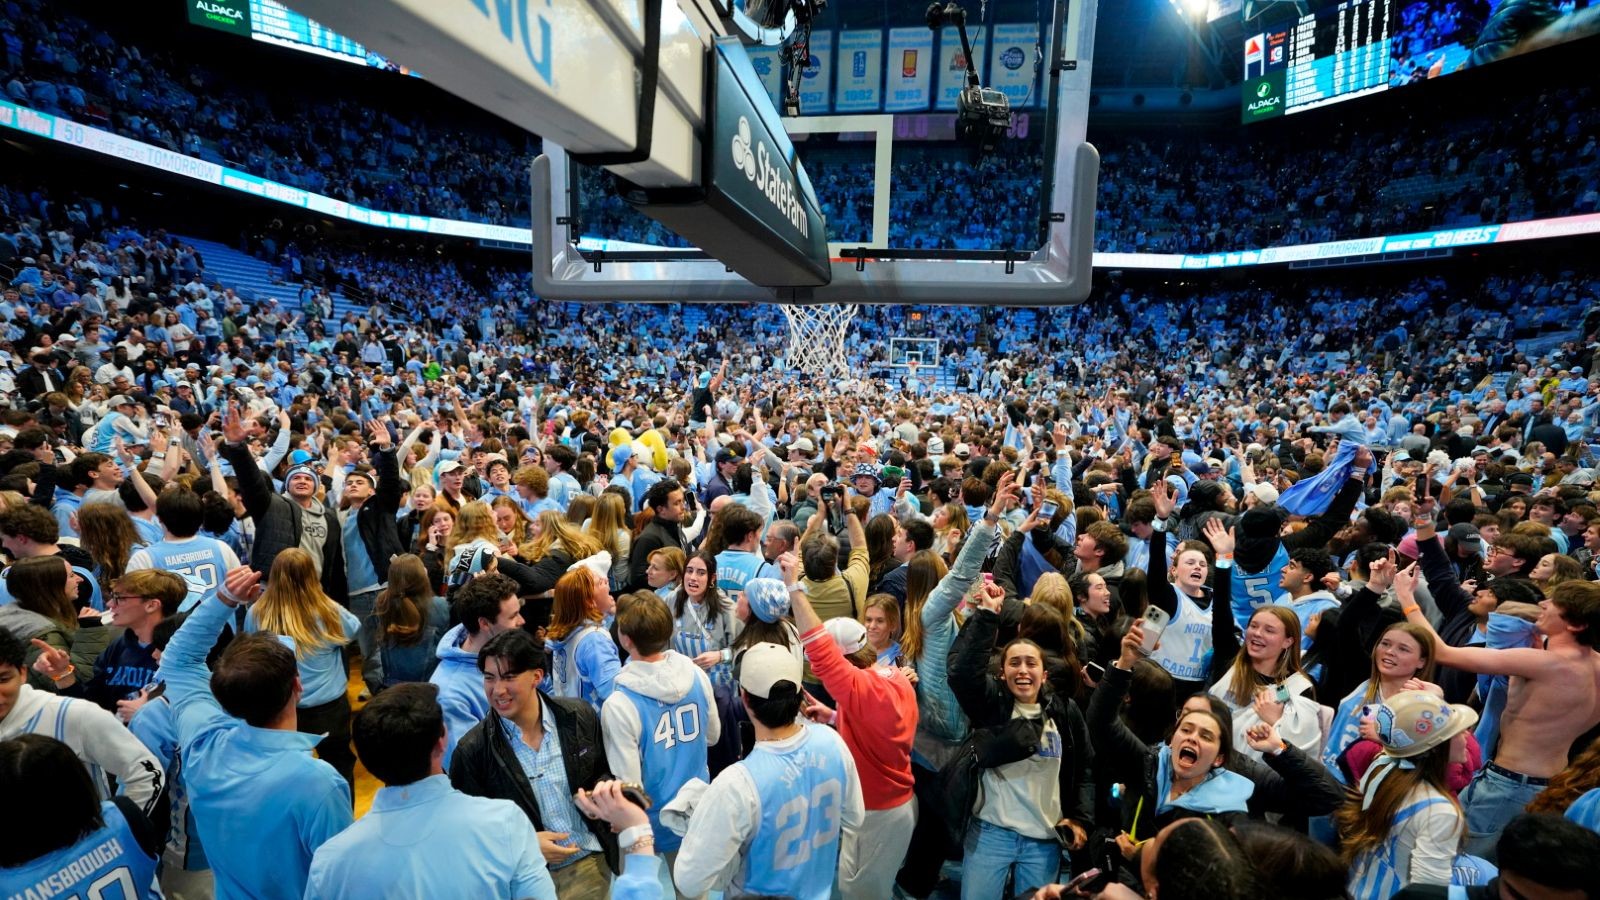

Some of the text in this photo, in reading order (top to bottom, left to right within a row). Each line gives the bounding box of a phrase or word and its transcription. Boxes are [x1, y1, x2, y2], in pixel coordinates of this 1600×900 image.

[196, 1, 243, 20] ALPACA
[206, 13, 236, 25] CHICKEN
[1247, 96, 1281, 112] ALPACA
[147, 148, 216, 181] TOMORROW
[1316, 237, 1380, 258] TOMORROW
[165, 548, 214, 567] HANSBROUGH
[1244, 577, 1274, 610] 5
[1184, 623, 1211, 635] NORT
[1189, 638, 1201, 663] 1
[653, 702, 700, 750] 40
[773, 778, 841, 870] 23
